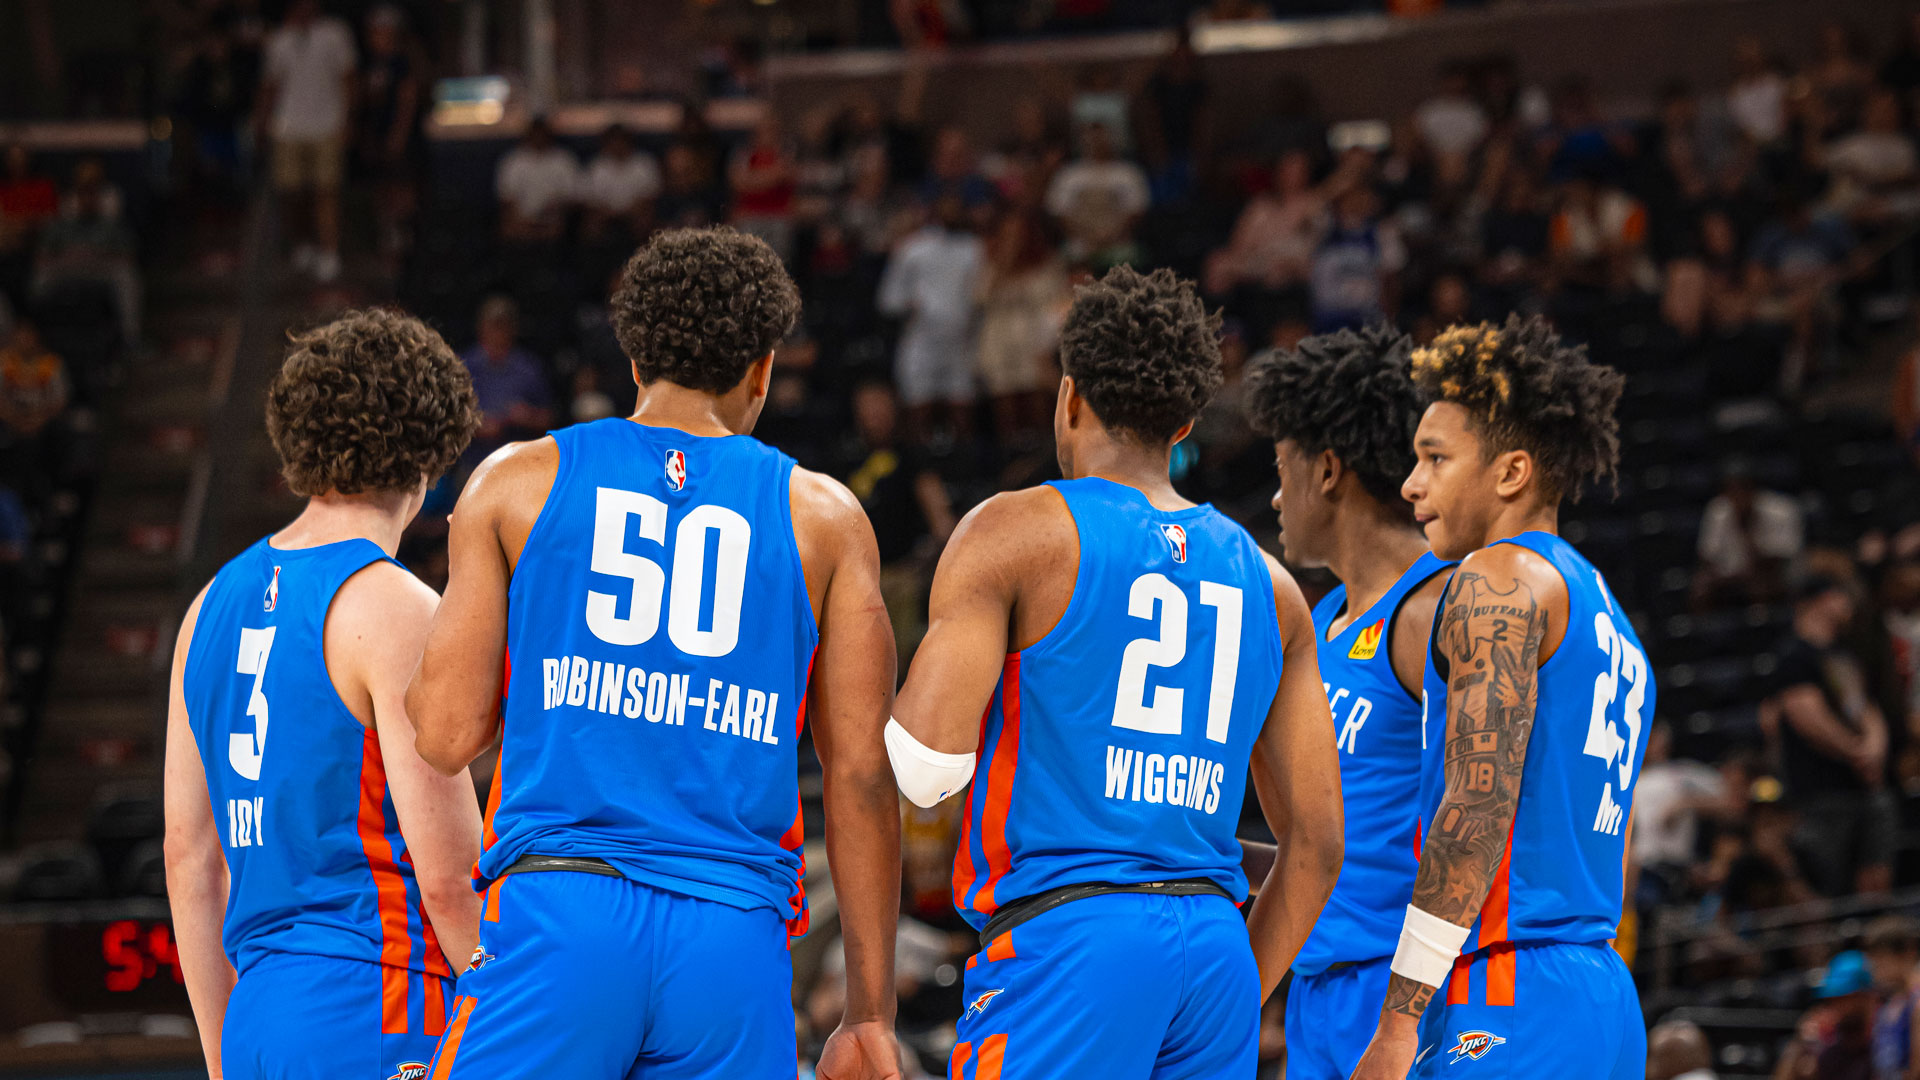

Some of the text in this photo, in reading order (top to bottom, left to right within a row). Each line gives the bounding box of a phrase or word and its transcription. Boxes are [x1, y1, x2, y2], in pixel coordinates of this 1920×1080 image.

[586, 487, 751, 657] 50
[1473, 605, 1531, 620] BUFFALO
[1492, 619, 1508, 642] 2
[1112, 573, 1243, 744] 21
[229, 626, 277, 780] 3
[543, 656, 779, 745] ROBINSON-EARL
[1584, 612, 1647, 791] 23
[1105, 745, 1225, 815] WIGGINS
[1464, 760, 1496, 794] 18
[1459, 1036, 1488, 1056] OKC
